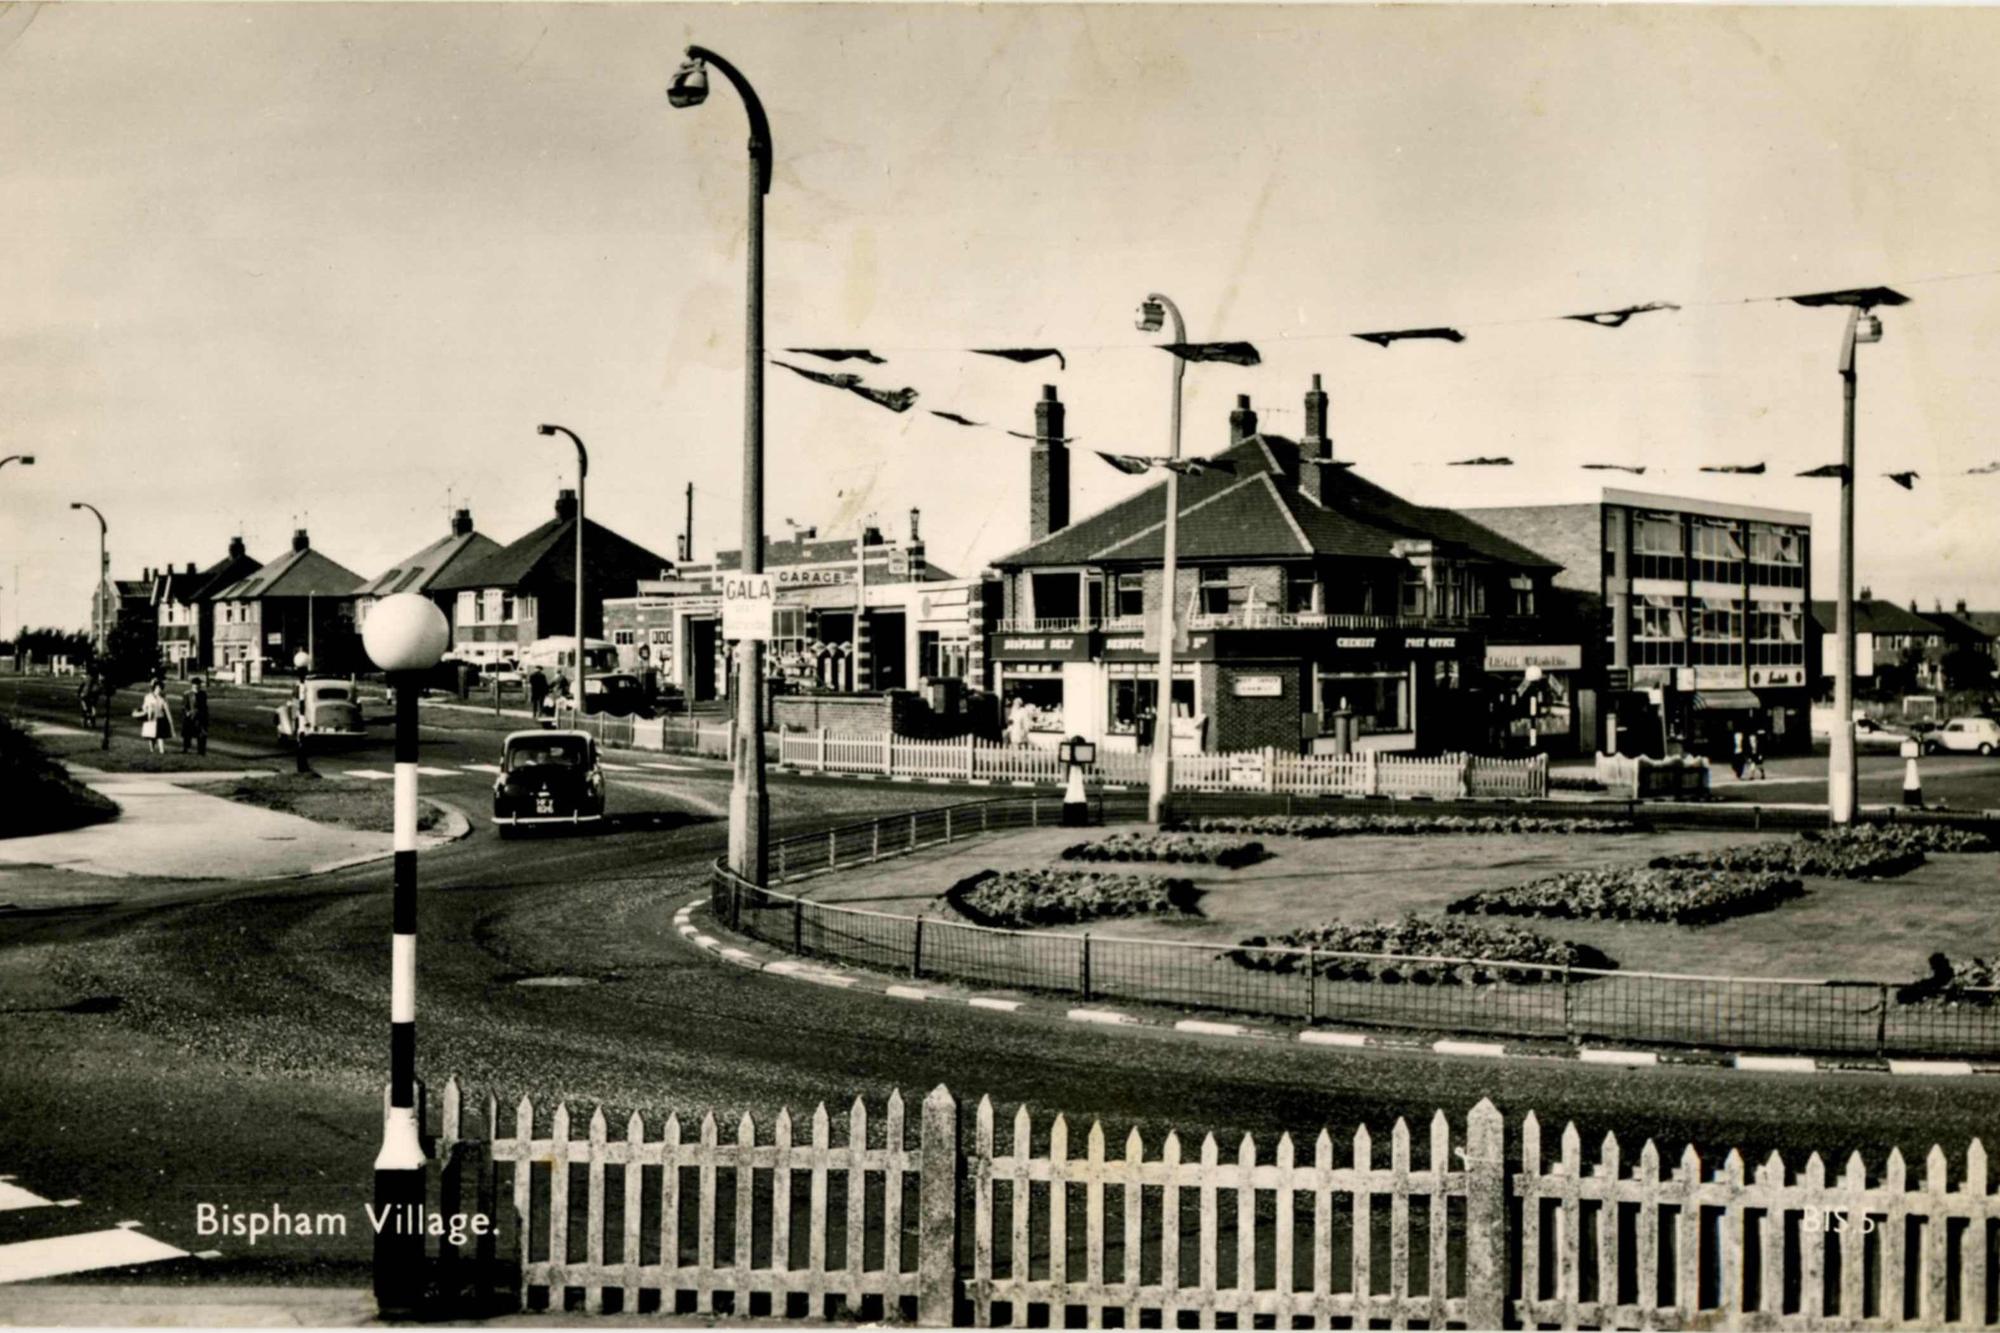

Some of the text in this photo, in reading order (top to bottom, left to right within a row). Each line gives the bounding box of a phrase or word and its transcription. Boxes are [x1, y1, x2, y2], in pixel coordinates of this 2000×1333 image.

[779, 572, 841, 583] GARAGE
[725, 580, 771, 600] GALA
[1337, 638, 1376, 648] CHEMIST
[1428, 638, 1456, 648] OFFICE
